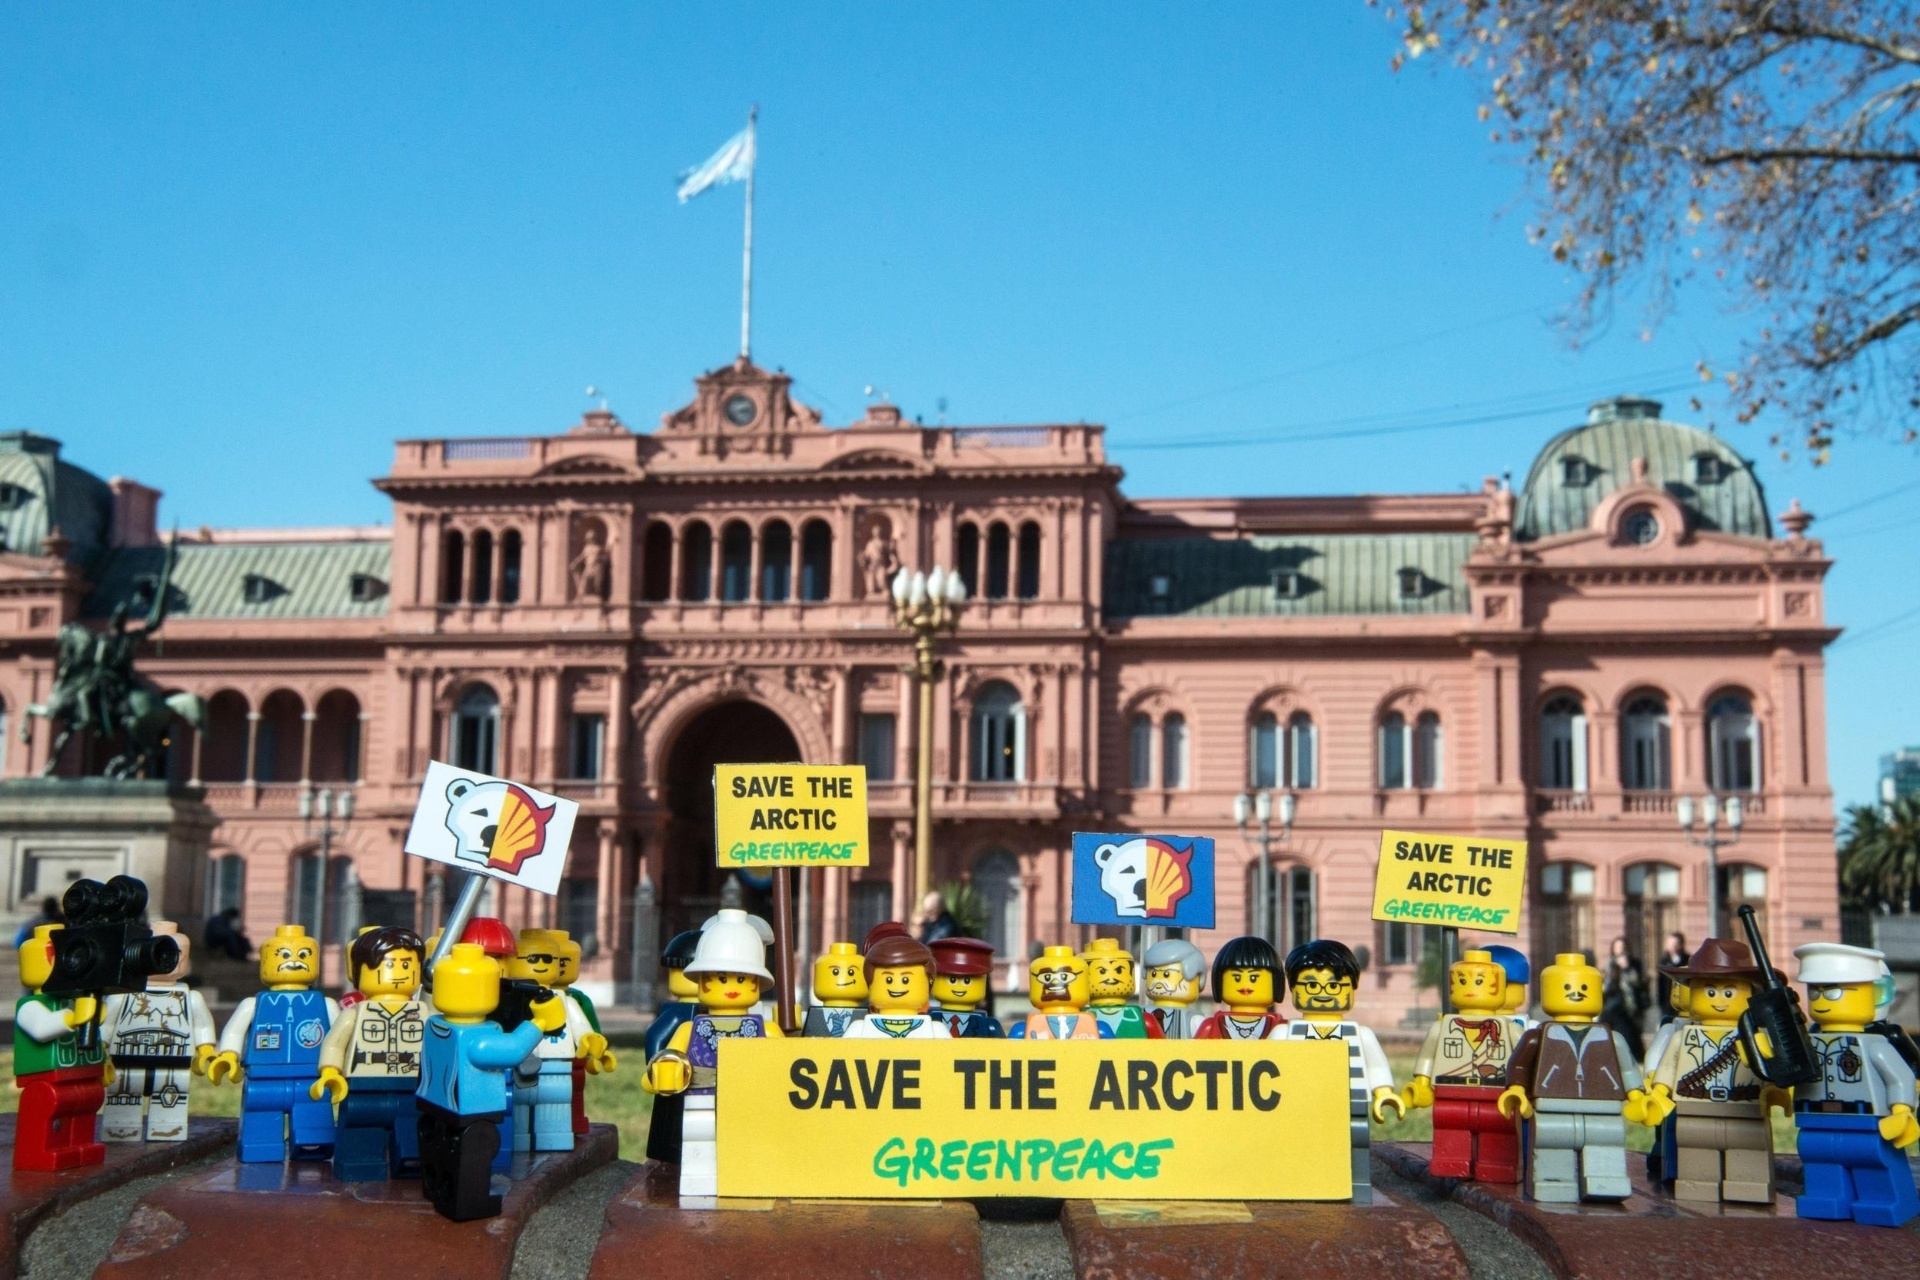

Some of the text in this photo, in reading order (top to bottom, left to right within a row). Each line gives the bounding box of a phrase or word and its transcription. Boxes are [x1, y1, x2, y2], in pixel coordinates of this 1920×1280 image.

[732, 776, 853, 798] SAVE THE
[750, 809, 837, 830] ARCTIC
[730, 841, 857, 863] GREENPEACE
[1395, 841, 1513, 869] SAVE THE
[1407, 872, 1492, 896] ARCTIC
[1384, 899, 1510, 925] GREENPEACE
[789, 1059, 1281, 1111] SAVE THE ARCTIC
[873, 1137, 1175, 1188] GREENPEACE
